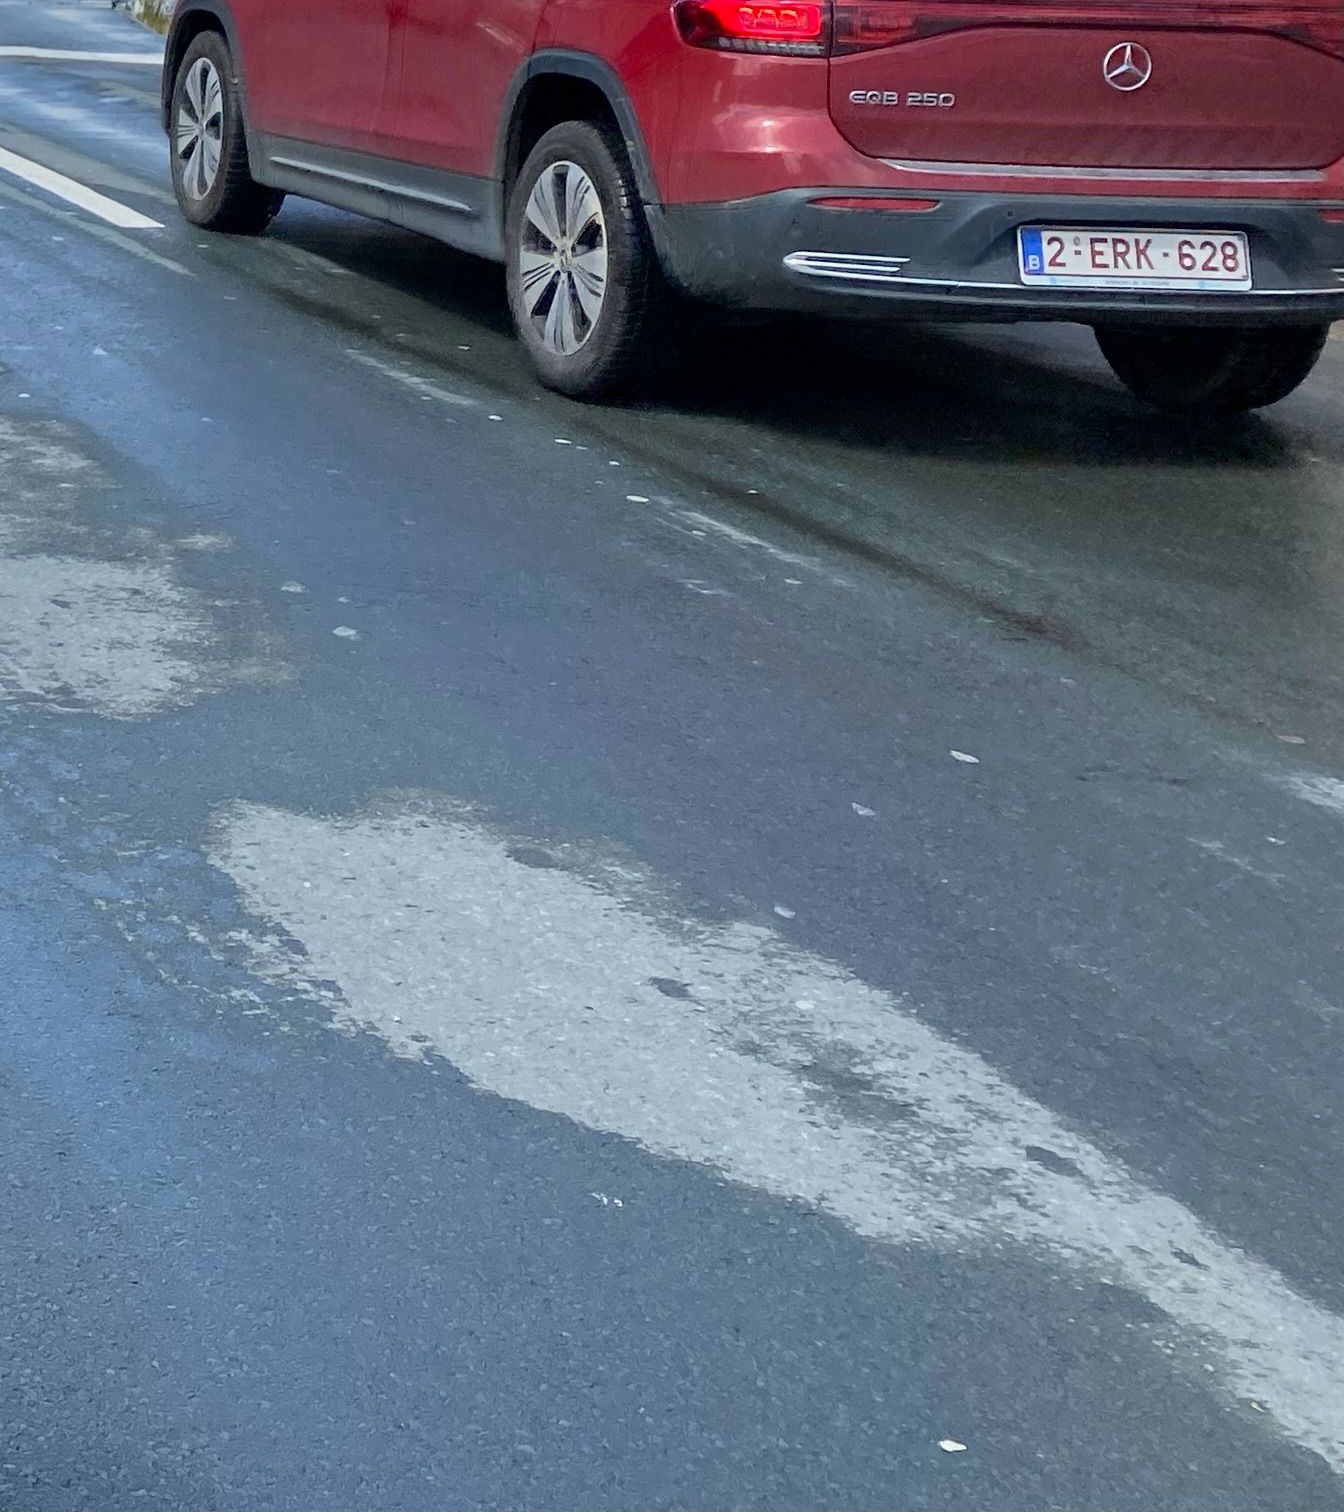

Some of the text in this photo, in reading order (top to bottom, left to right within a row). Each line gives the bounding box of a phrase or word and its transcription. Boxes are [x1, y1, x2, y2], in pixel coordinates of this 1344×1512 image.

[849, 90, 954, 106] EQB 250
[1028, 254, 1040, 270] B
